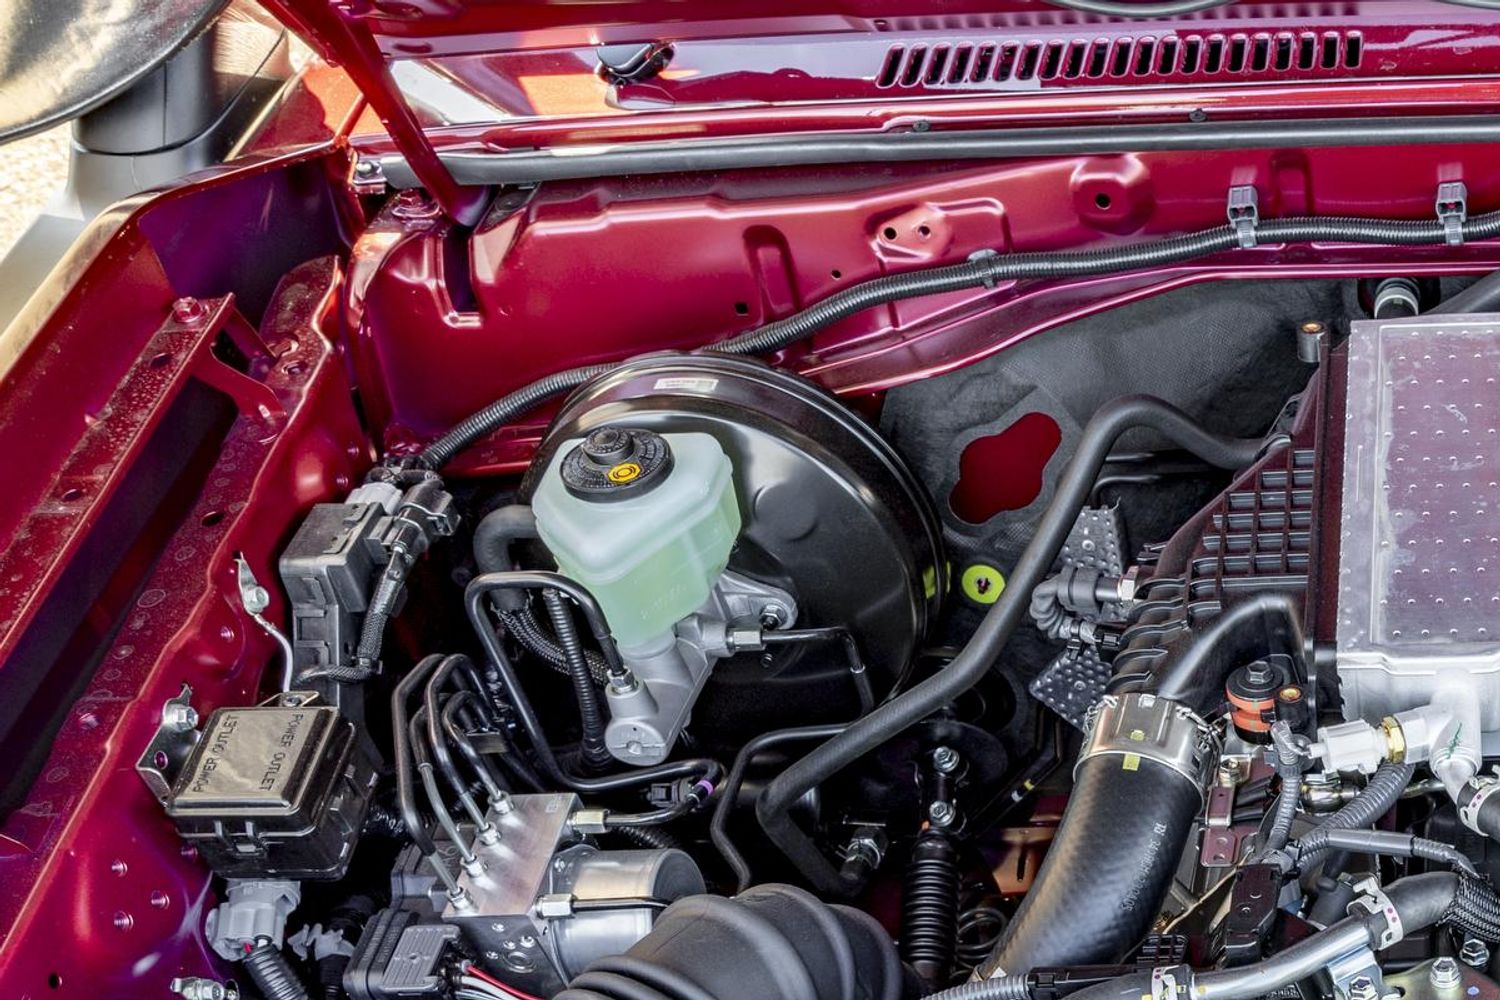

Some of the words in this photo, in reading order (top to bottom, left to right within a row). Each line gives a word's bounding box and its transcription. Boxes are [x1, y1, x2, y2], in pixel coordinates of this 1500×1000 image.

[280, 713, 304, 749] POWER
[192, 756, 218, 793] POWER
[211, 714, 240, 755] OUTLET
[258, 751, 287, 792] OUTLET
